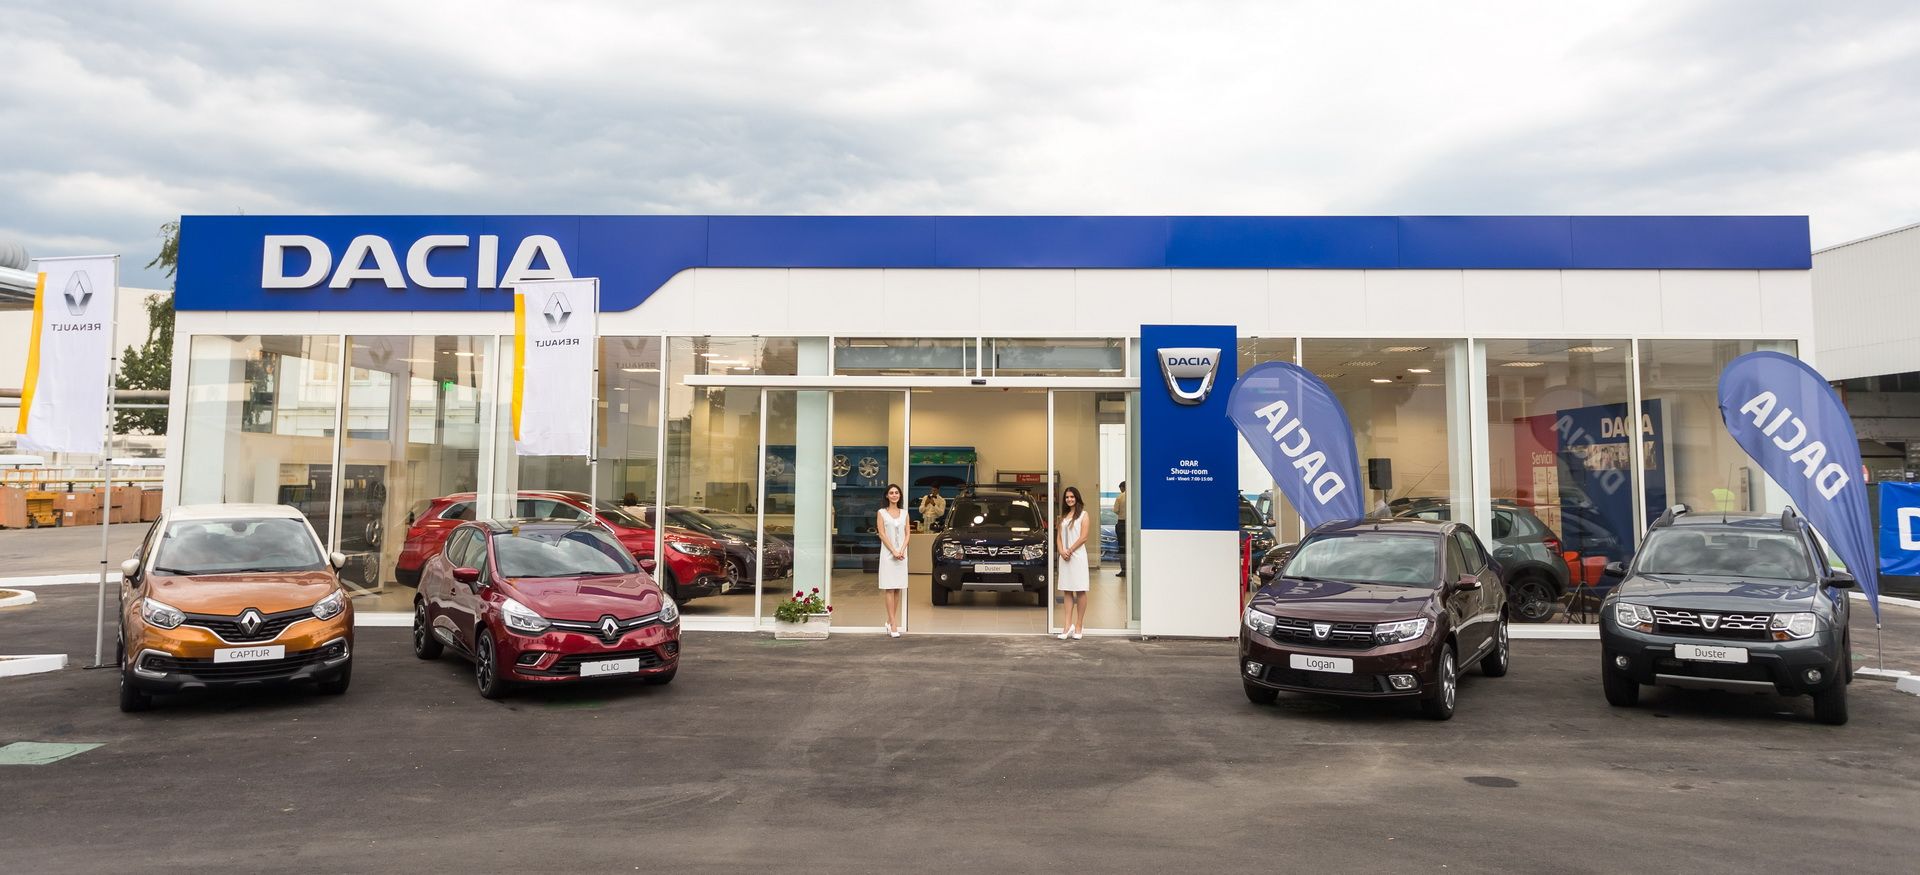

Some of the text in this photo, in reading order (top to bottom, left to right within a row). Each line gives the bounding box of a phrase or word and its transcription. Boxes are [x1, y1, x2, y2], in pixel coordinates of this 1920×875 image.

[262, 235, 573, 289] DACIA
[1168, 357, 1211, 366] DACIA
[1531, 451, 1553, 465] Servicii
[1170, 467, 1208, 475] Show-room
[230, 649, 270, 659] CAPTUR
[1695, 648, 1726, 658] Duster
[601, 663, 619, 671] CLIO
[1306, 657, 1335, 670] Logan
